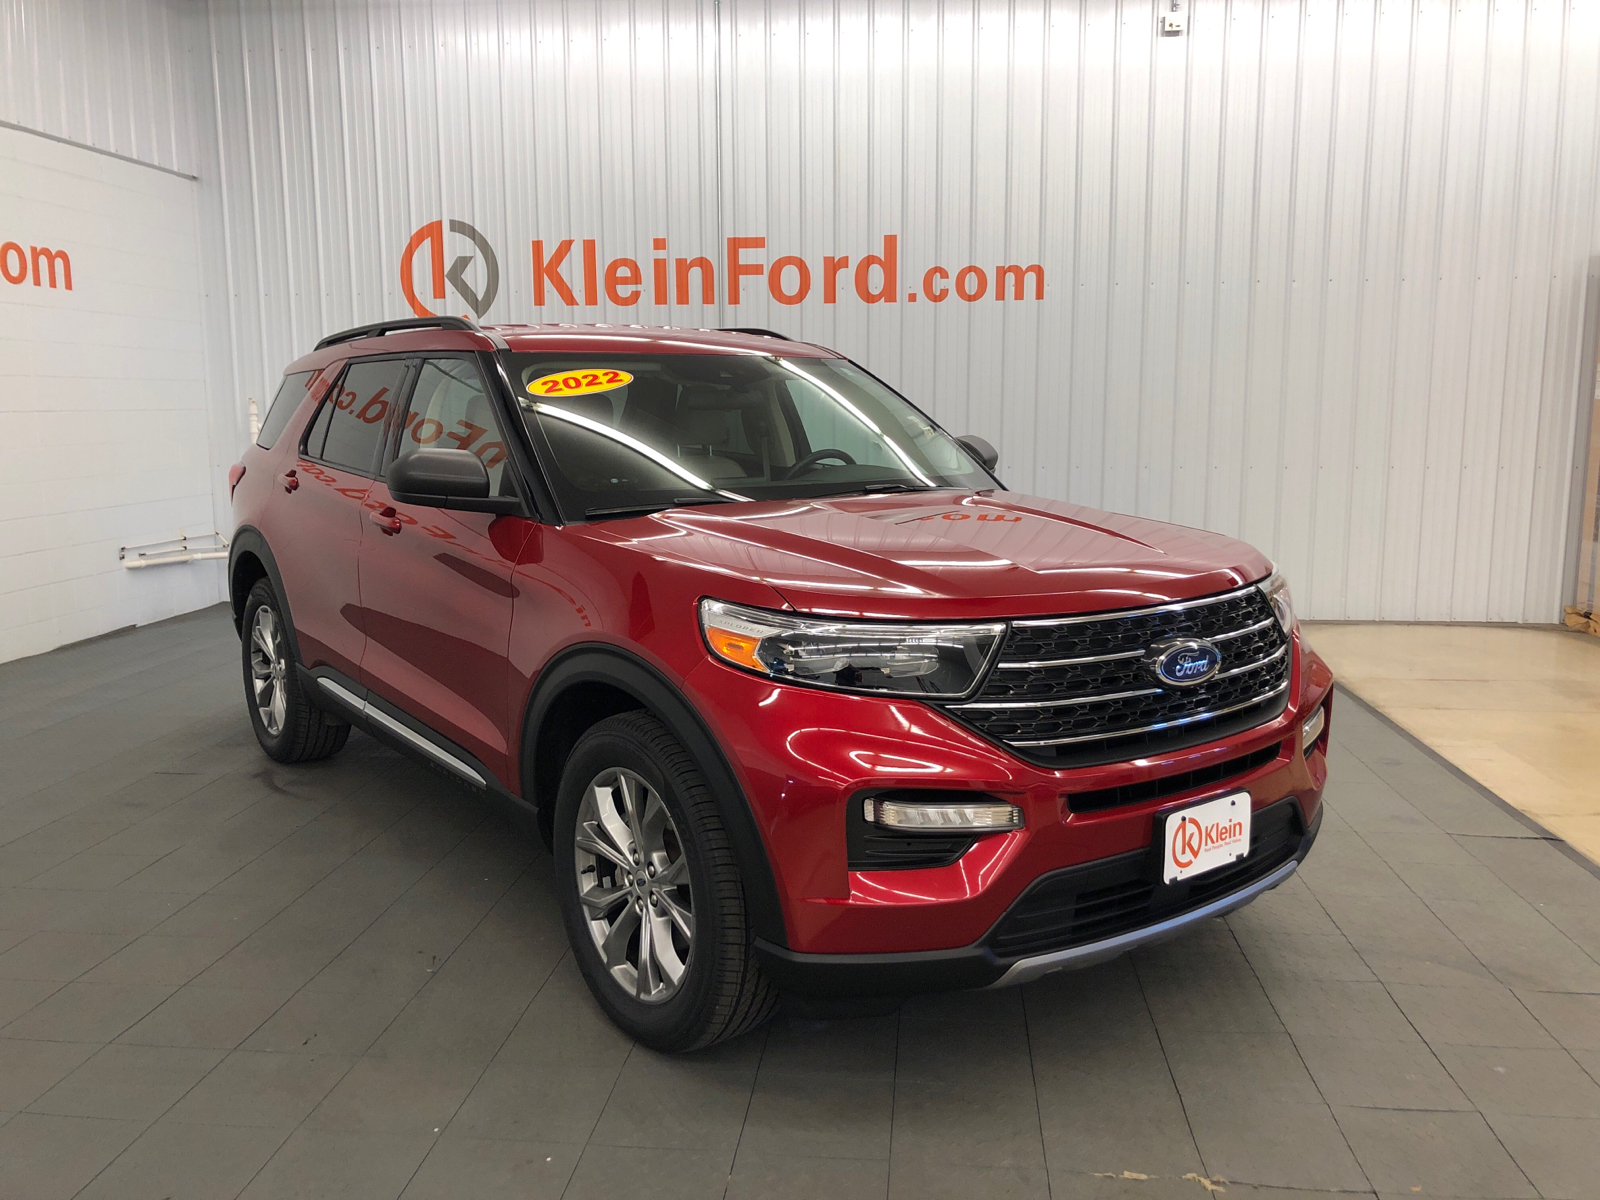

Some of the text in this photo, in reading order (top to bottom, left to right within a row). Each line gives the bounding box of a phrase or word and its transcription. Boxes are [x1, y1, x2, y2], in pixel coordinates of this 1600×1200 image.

[531, 234, 1045, 306] KleinFord.com
[541, 371, 624, 394] 2022
[1175, 651, 1210, 677] Ford
[1204, 818, 1243, 847] Klein
